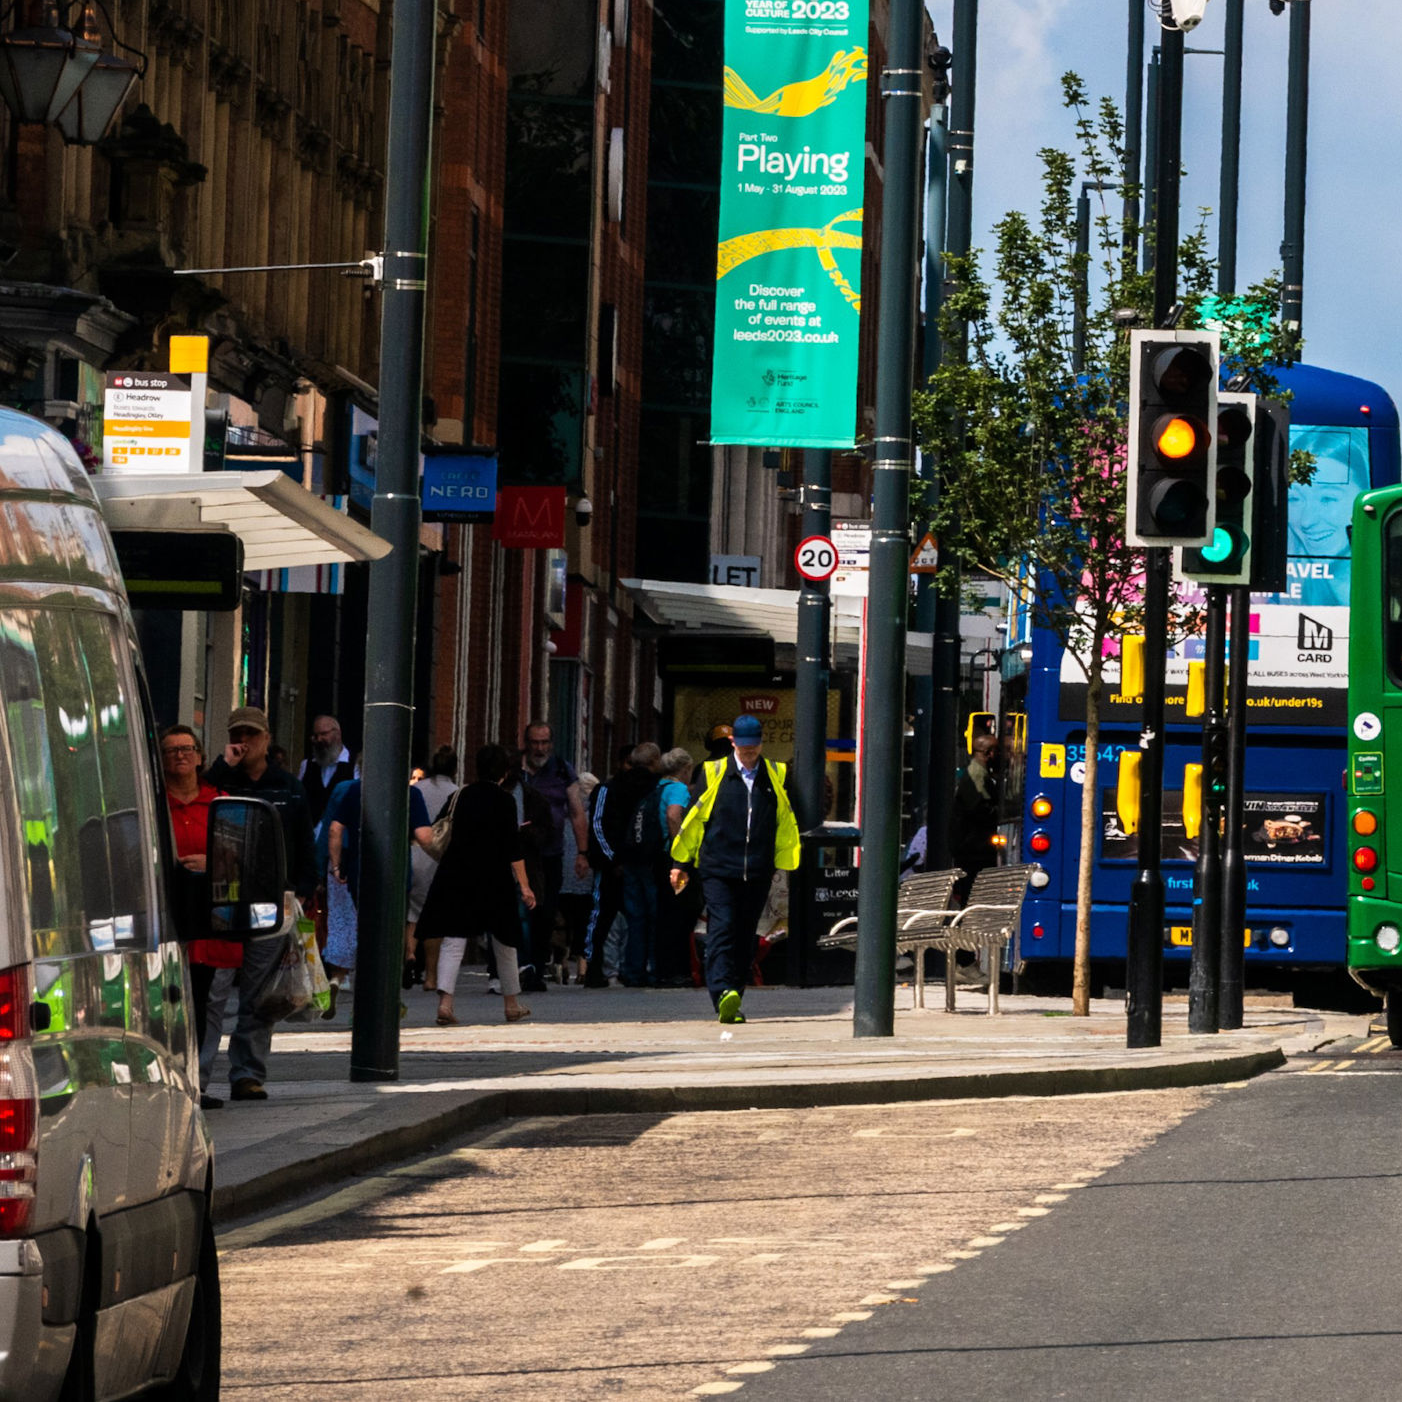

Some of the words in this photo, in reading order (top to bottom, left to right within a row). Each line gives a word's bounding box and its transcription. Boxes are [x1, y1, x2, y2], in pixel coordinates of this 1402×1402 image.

[745, 0, 774, 10] YEAR
[774, 0, 788, 10] OF
[792, 0, 850, 20] 2023
[744, 8, 790, 18] CULTURE
[745, 26, 778, 35] Supported
[779, 26, 788, 36] by
[788, 27, 808, 36] Leeds
[808, 28, 822, 36] City
[823, 28, 848, 36] Council
[738, 132, 758, 142] Part
[760, 132, 778, 142] Two
[737, 144, 850, 182] Playing
[738, 183, 742, 192] 1
[744, 183, 765, 195] May
[772, 184, 784, 194] 31
[784, 184, 818, 197] August
[820, 184, 848, 196] 2023
[749, 284, 805, 298] Discover
[734, 298, 756, 310] the
[758, 298, 778, 311] full
[780, 302, 816, 315] range
[748, 313, 762, 325] of
[764, 315, 806, 327] events
[808, 316, 822, 327] at
[733, 328, 840, 344] leeds2023.co.uk
[134, 378, 149, 387] bus
[150, 378, 168, 388] stop
[430, 486, 488, 498] NERO
[513, 496, 552, 526] M
[802, 549, 832, 568] 20
[712, 564, 757, 587] LET
[1286, 562, 1334, 579] AVEL
[1296, 652, 1332, 664] CARD
[744, 698, 774, 710] NEW
[1110, 694, 1132, 704] Find
[1246, 696, 1322, 708] o.uk/under19s
